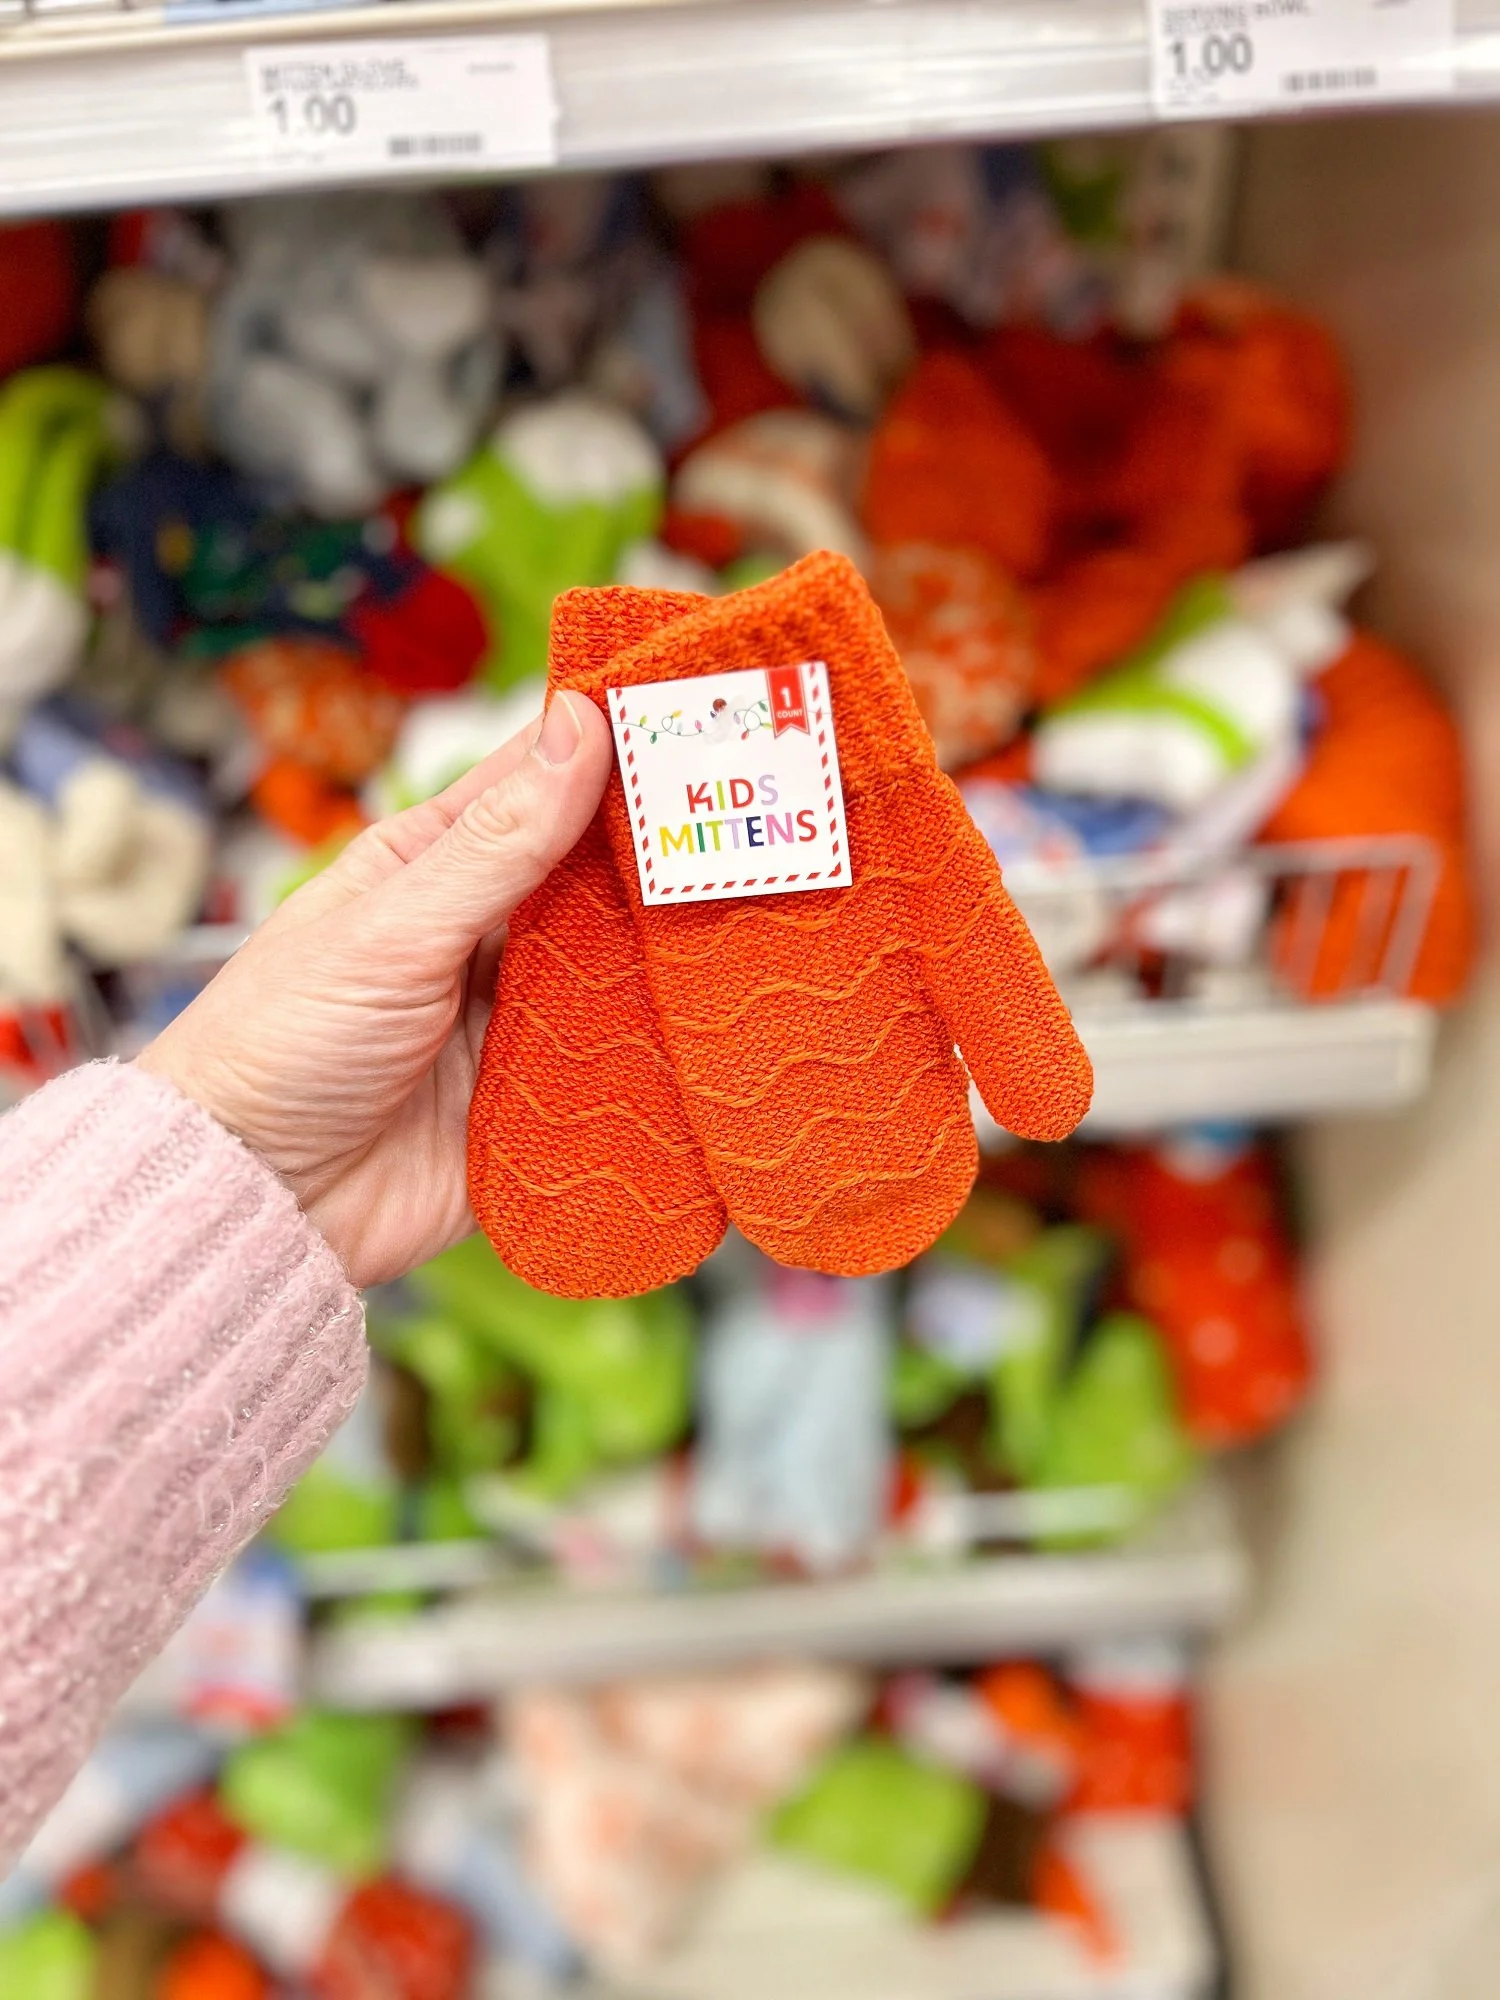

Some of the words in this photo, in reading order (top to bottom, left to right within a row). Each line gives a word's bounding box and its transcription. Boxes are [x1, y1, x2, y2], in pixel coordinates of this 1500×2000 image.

[1168, 31, 1254, 77] 1.00
[267, 93, 358, 135] 1.00
[776, 708, 803, 719] COUNT
[781, 687, 791, 708] 1
[686, 774, 779, 814] KIDS
[659, 809, 818, 857] MITTENS
